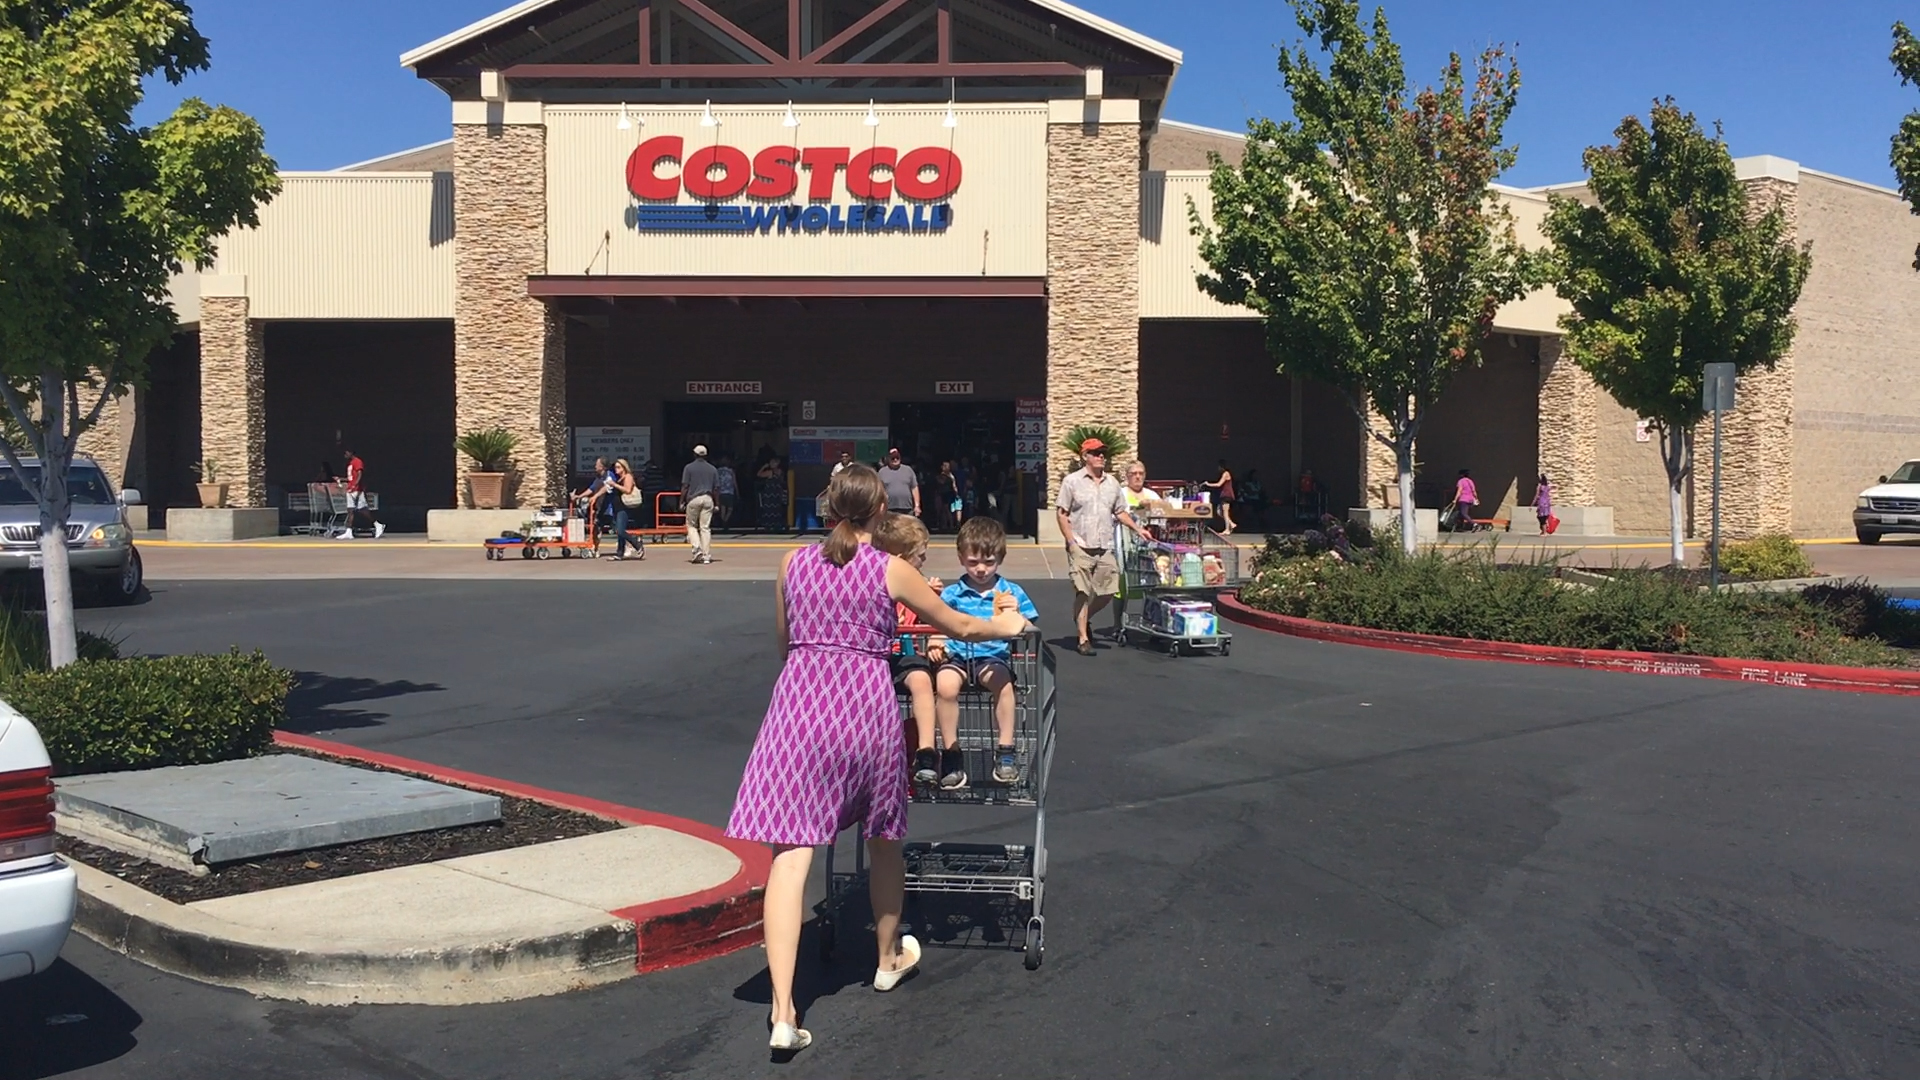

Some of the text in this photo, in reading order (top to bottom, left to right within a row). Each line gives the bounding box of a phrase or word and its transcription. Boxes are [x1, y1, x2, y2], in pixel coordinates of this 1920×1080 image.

[626, 135, 962, 202] COSTCO
[742, 205, 951, 233] WHOLESALE
[688, 382, 760, 393] ENTRANCE
[939, 382, 970, 393] EXIT
[1633, 659, 1701, 676] NO PARKING
[1741, 667, 1807, 687] FIRE LANE
